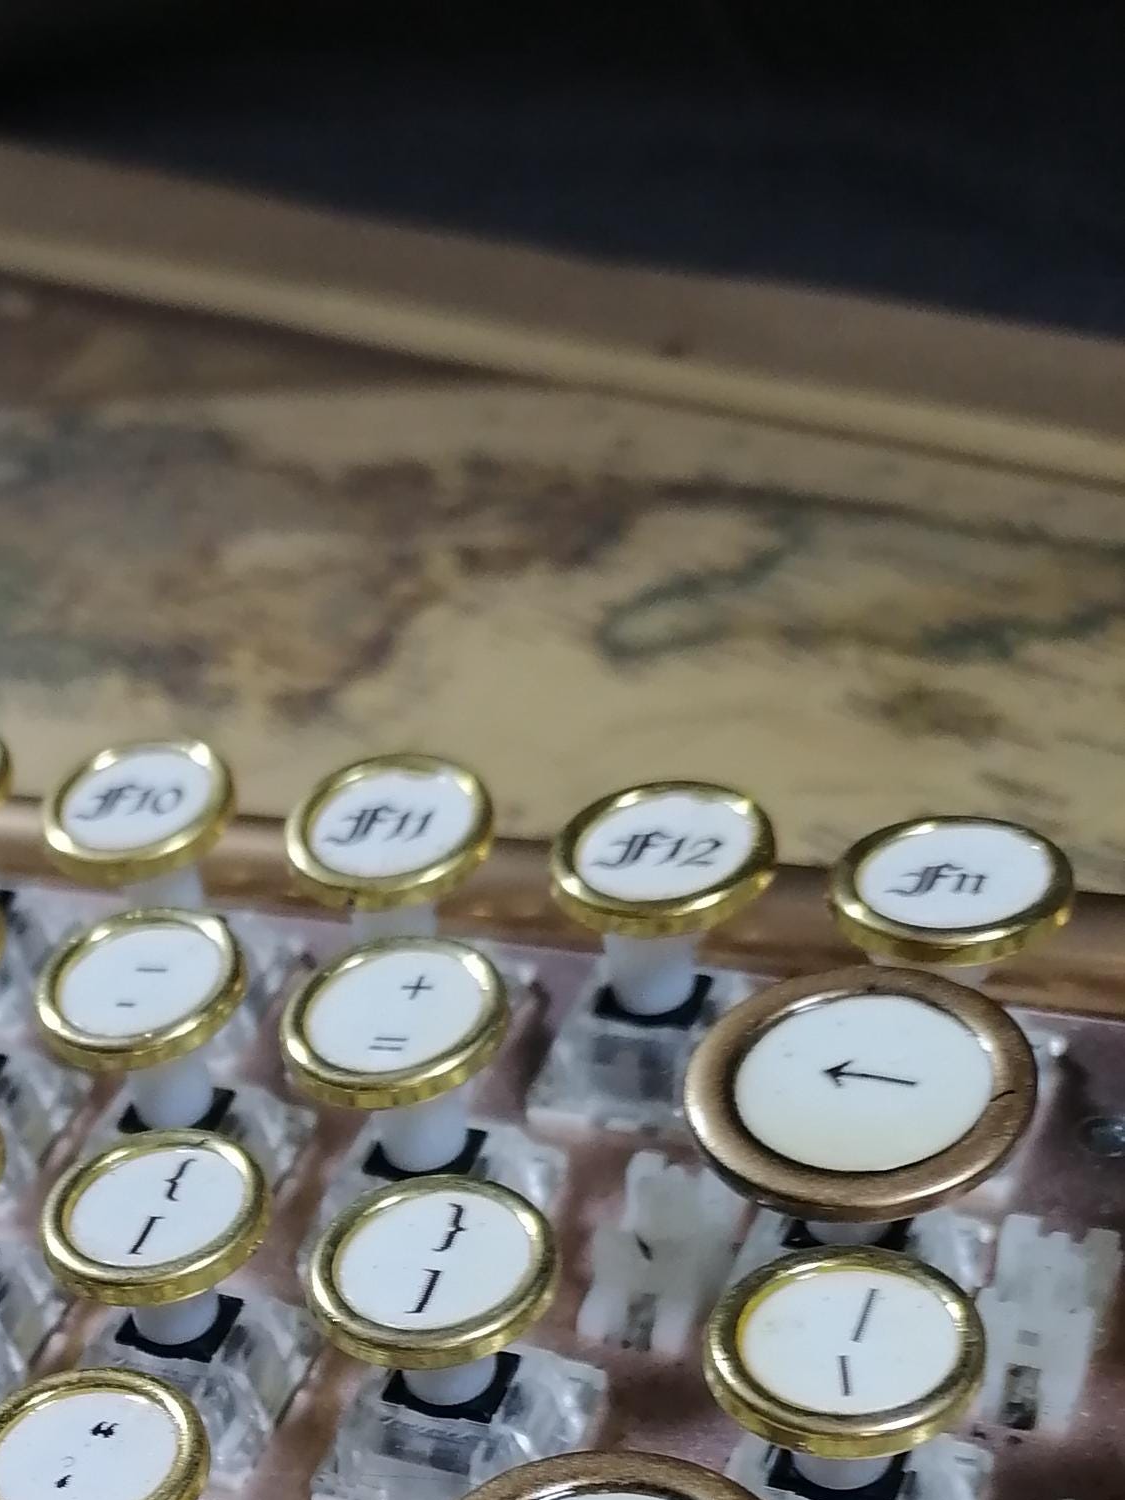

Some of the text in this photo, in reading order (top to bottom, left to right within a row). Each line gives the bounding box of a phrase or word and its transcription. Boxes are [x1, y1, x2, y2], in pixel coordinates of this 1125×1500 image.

[76, 786, 186, 822] F10
[323, 804, 435, 846] F11
[593, 831, 722, 869] F12
